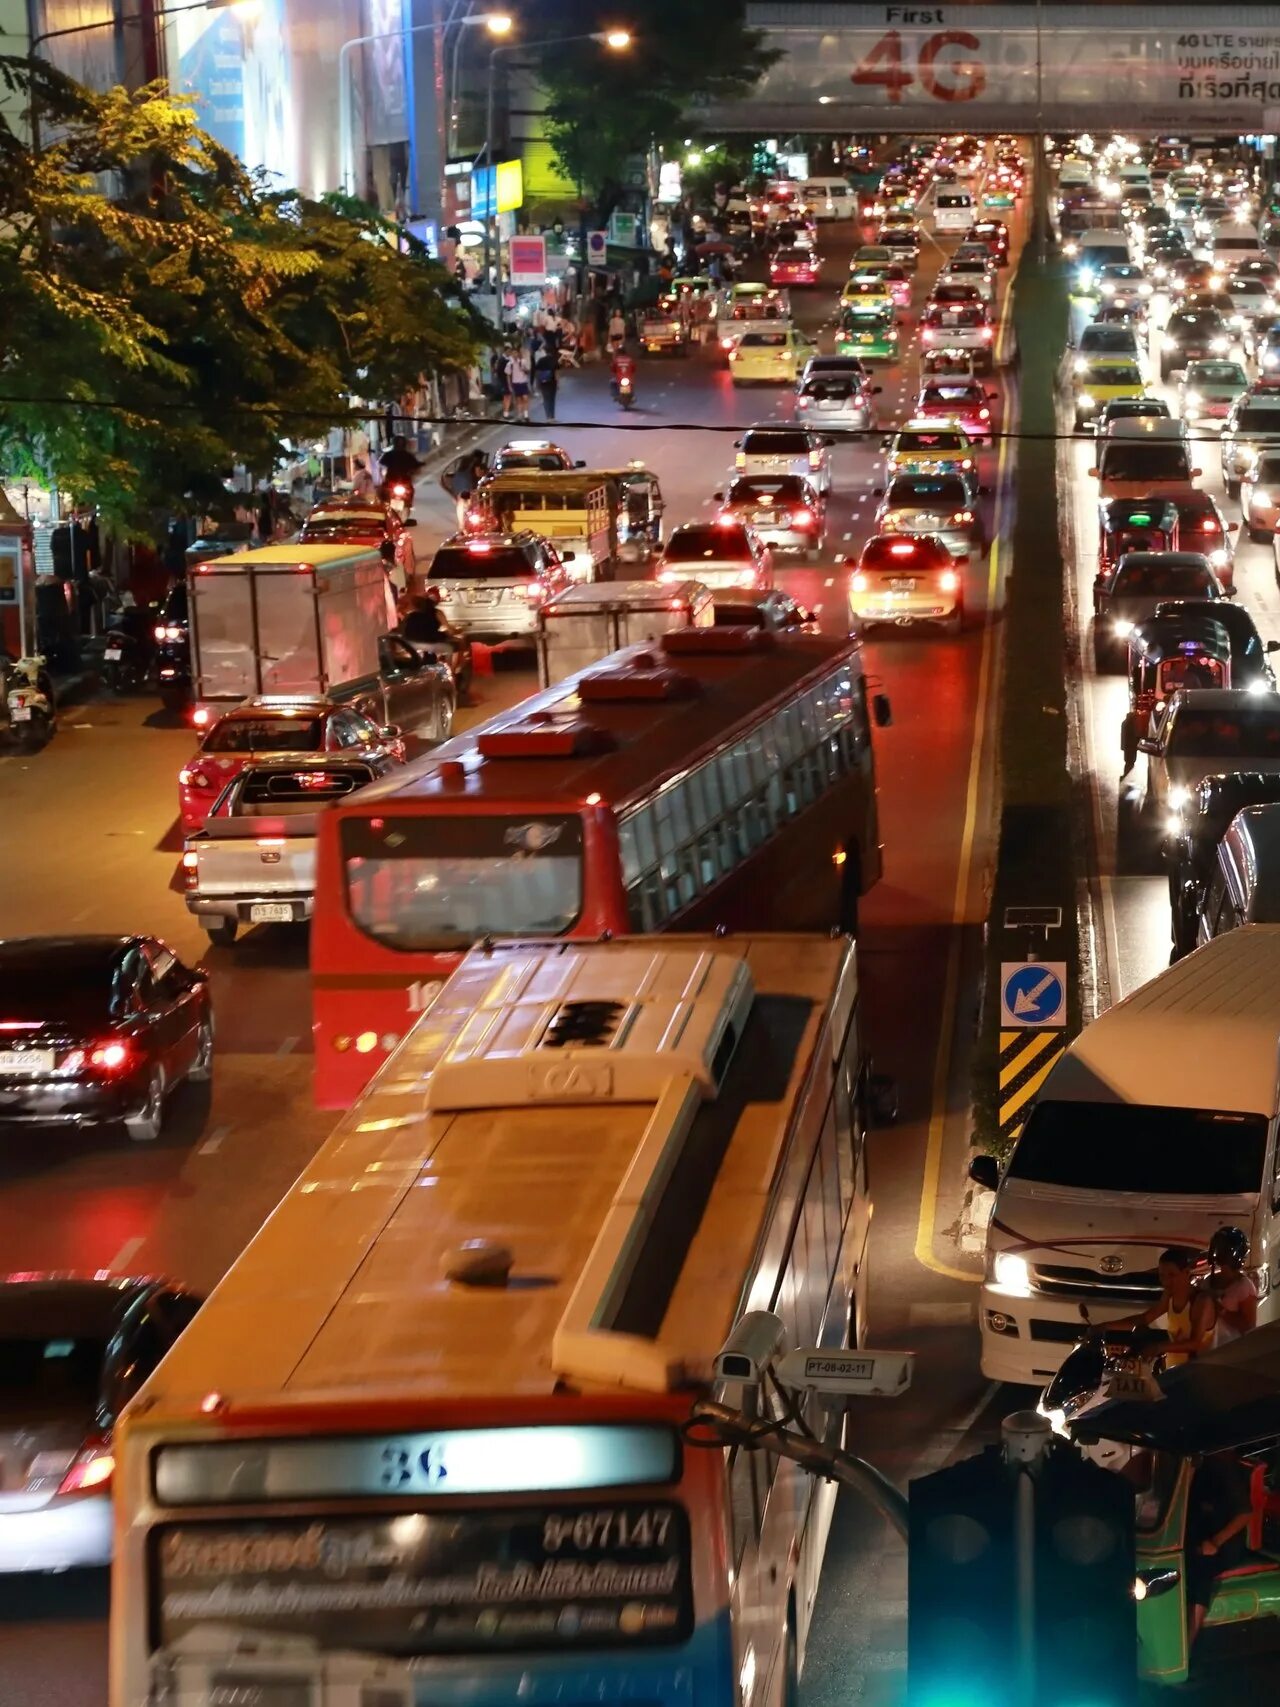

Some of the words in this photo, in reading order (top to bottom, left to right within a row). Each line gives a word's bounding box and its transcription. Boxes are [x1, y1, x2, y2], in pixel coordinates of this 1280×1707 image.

[886, 7, 944, 24] First
[1177, 34, 1199, 48] 4G
[1202, 34, 1233, 48] LTE
[850, 30, 986, 103] 4G
